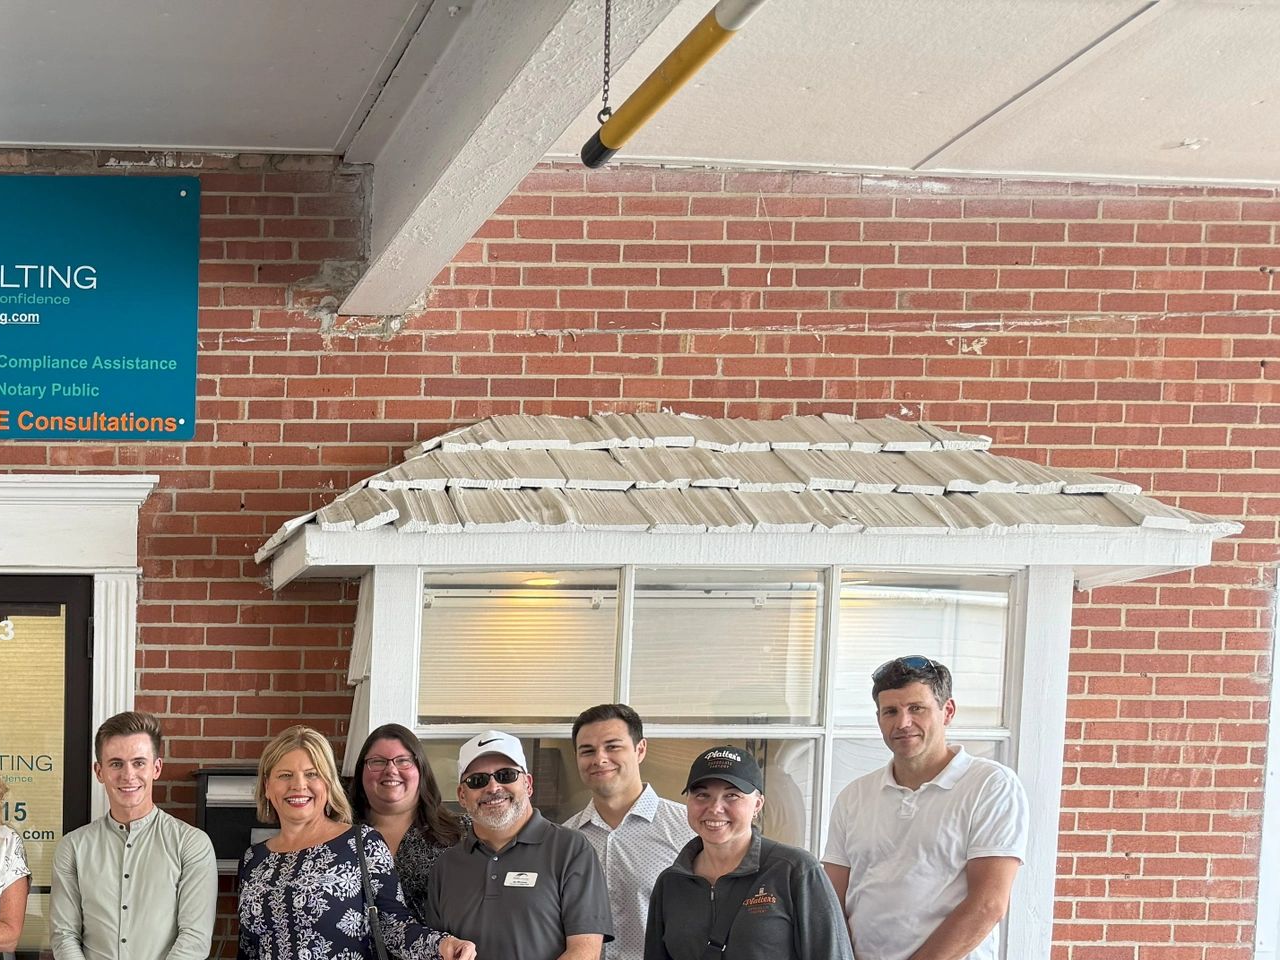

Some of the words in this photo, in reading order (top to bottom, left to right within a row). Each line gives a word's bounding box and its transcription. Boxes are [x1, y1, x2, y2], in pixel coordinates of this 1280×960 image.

[92, 356, 177, 370] Assistance
[51, 383, 100, 397] Public
[18, 411, 177, 432] Consultations
